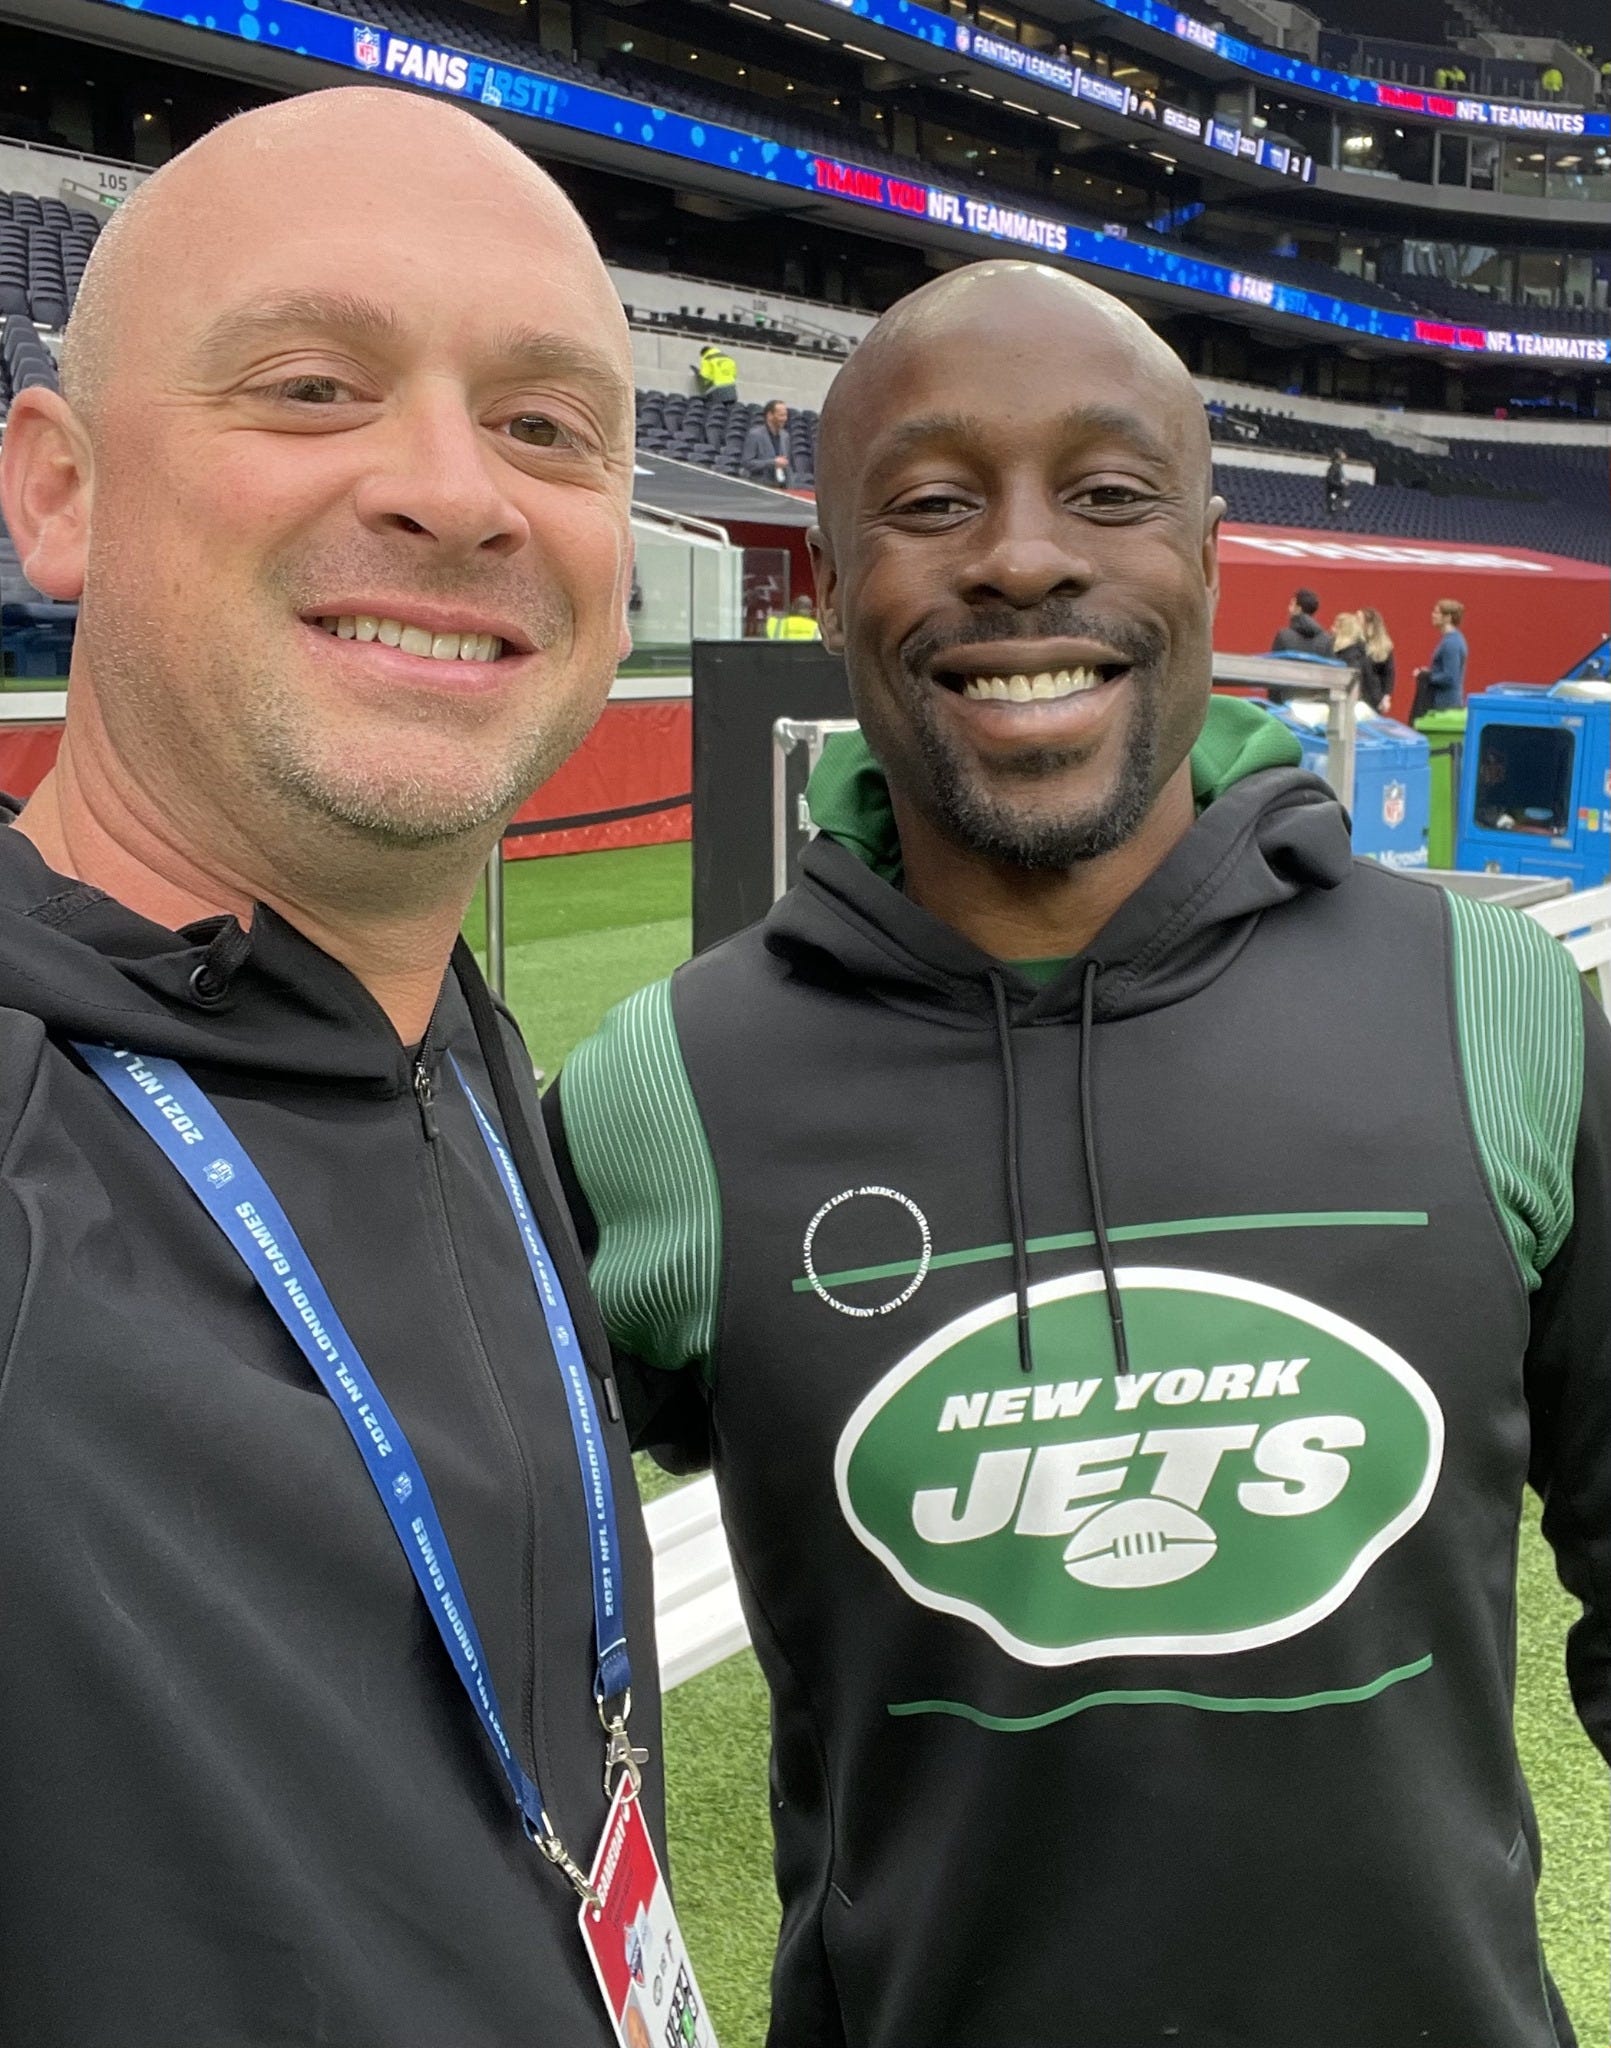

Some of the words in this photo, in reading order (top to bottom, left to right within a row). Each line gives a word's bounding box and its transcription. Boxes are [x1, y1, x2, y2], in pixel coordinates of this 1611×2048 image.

[385, 38, 468, 90] FANS
[973, 35, 1024, 70] FANTASY
[1456, 101, 1488, 122] NFL
[1489, 104, 1585, 135] TEAMMATES
[98, 172, 128, 192] 105
[814, 159, 883, 202] THANK
[888, 179, 926, 214] YOU
[928, 190, 964, 225] NFL
[966, 200, 1067, 250] TEAMMATES
[1487, 331, 1513, 353] NFL
[1515, 333, 1608, 361] TEAMMATES
[126, 1056, 164, 1095] NFL
[154, 1094, 204, 1145] 2021
[497, 1146, 527, 1220] LONDON
[860, 1186, 908, 1204] AMERICAN
[234, 1200, 291, 1276] GAMES
[284, 1277, 339, 1362] LONDON
[335, 1361, 363, 1403] NFL
[568, 1364, 592, 1434] GAMES
[937, 1377, 1103, 1432] NEW
[1113, 1357, 1311, 1411] YORK
[358, 1403, 393, 1457] 2021
[586, 1439, 606, 1520] LONDON
[912, 1415, 1367, 1544] JETS
[411, 1516, 447, 1592] GAMES
[598, 1524, 611, 1562] NFL
[603, 1566, 615, 1617] 2021
[441, 1591, 479, 1672] LONDON
[596, 1815, 626, 1908] GAMEDAY
